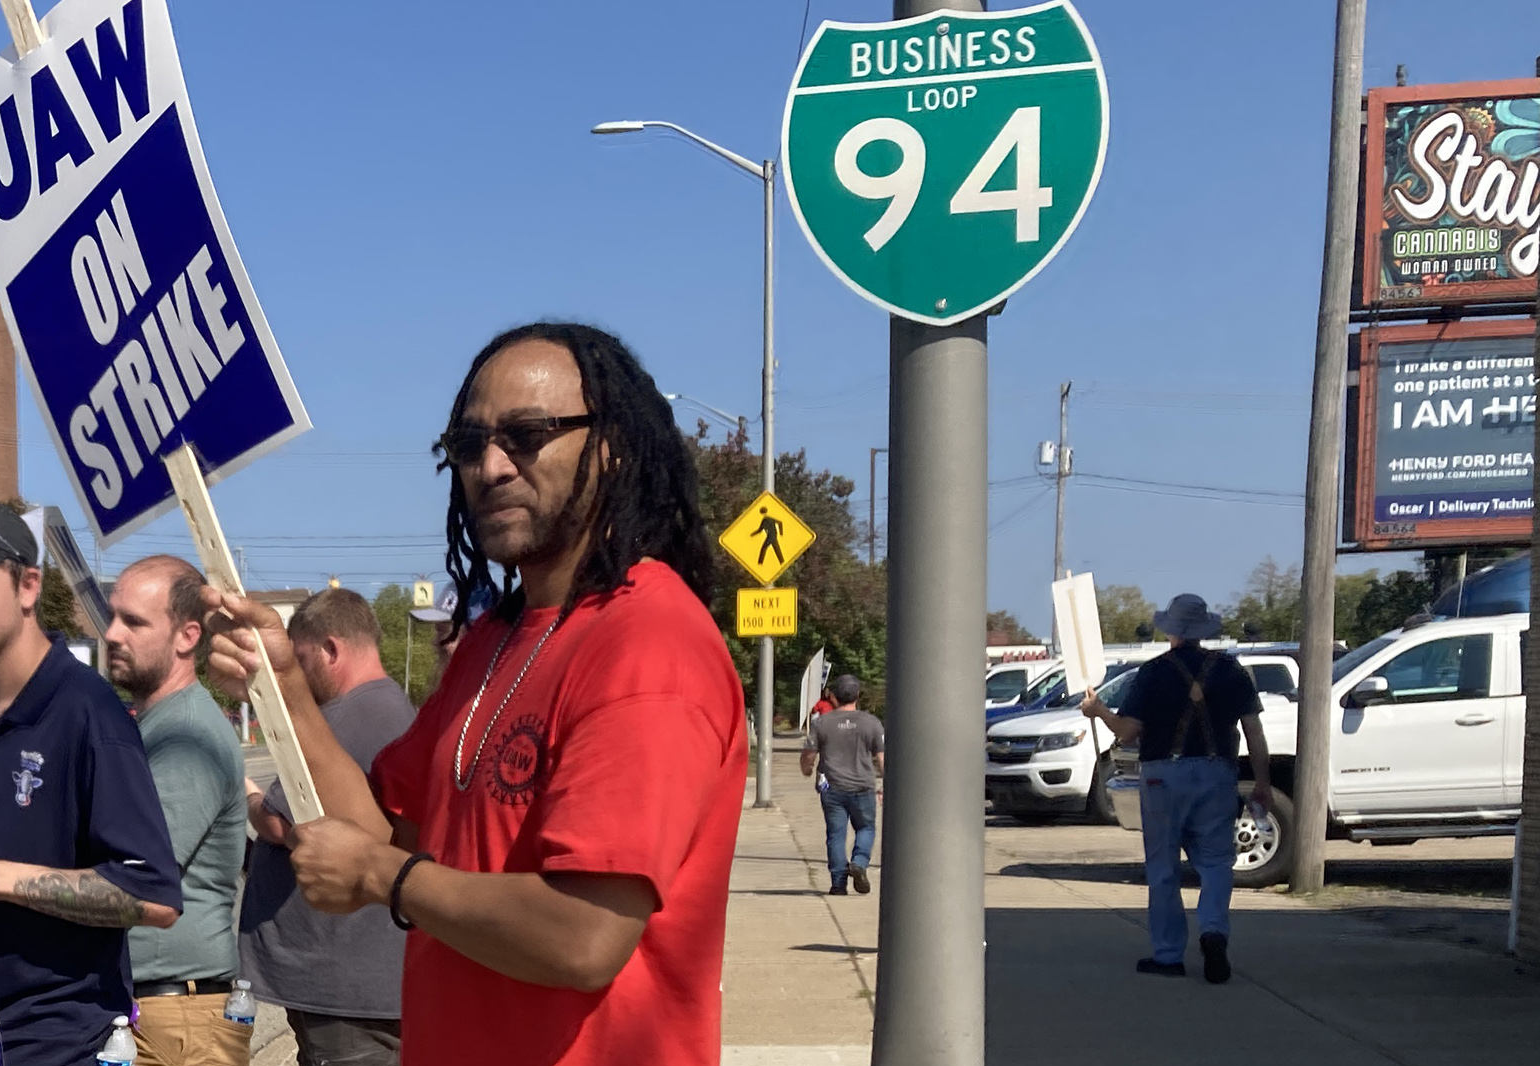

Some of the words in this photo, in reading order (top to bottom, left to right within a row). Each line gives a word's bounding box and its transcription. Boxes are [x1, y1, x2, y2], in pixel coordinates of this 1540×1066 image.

[850, 26, 1037, 78] BUSINESS
[907, 85, 978, 113] LOOP
[834, 106, 1054, 253] 94
[1394, 112, 1539, 275] Stay
[1396, 229, 1499, 255] CANNABIS
[70, 188, 152, 346] ON
[1401, 259, 1448, 275] WOMAN
[1455, 257, 1497, 272] OWNED
[69, 243, 246, 511] STRIKE
[1452, 360, 1462, 371] a
[1394, 379, 1424, 393] one
[1429, 375, 1489, 396] patient
[1493, 374, 1511, 388] at
[1514, 376, 1524, 388] a
[1393, 401, 1402, 430] I
[1411, 398, 1474, 430] AM
[1388, 456, 1448, 471] HENRY
[1452, 453, 1496, 468] FORD
[1389, 502, 1425, 516] Oscar
[1438, 499, 1490, 515] Delivery
[753, 597, 781, 610] NEXT
[771, 615, 792, 628] FEET
